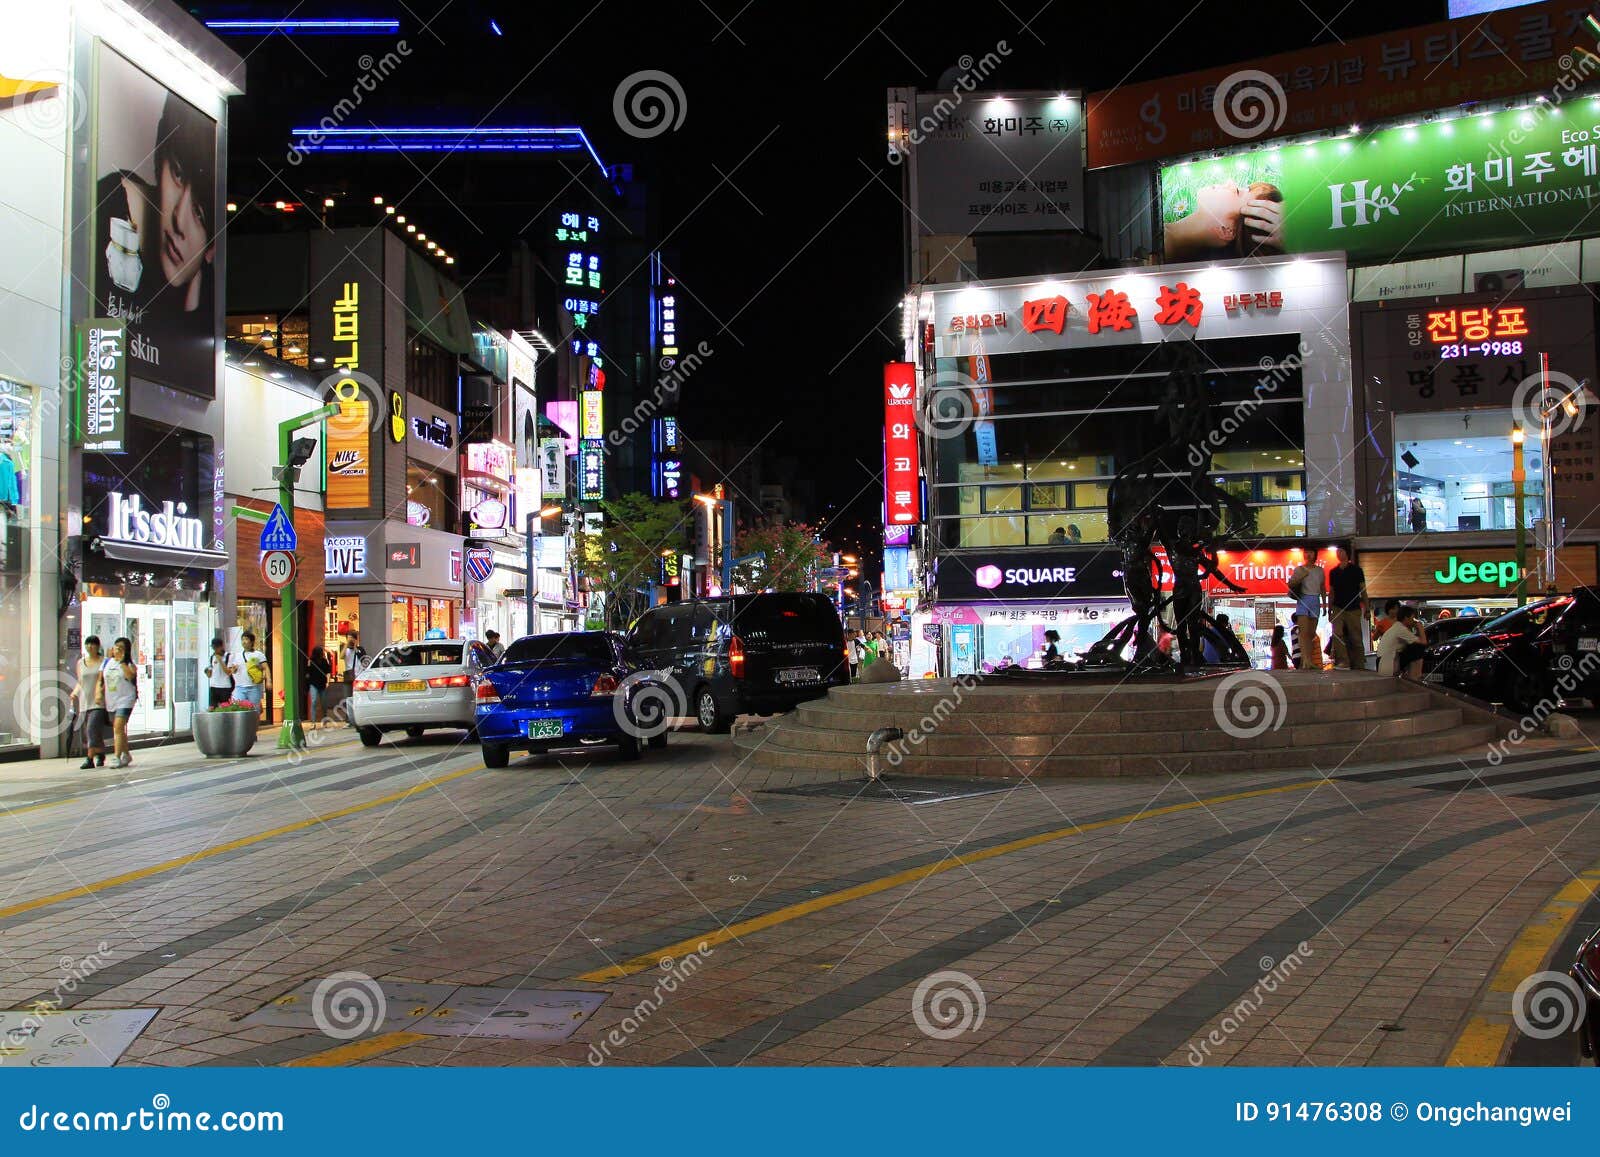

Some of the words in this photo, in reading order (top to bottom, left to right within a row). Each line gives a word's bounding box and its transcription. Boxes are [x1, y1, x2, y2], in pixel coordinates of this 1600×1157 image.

[983, 117, 1045, 137] 화미주
[1048, 119, 1070, 133] (주)
[1561, 129, 1589, 144] Eco
[1444, 184, 1593, 217] INTERNATIONAL
[1023, 281, 1204, 335] 四海坊
[1223, 291, 1284, 312] 만두전문
[951, 312, 1008, 332] 중화요리
[1426, 307, 1529, 343] 전당포
[88, 328, 97, 368] CLINICAL
[99, 328, 122, 370] It's
[130, 333, 160, 365] skin
[1440, 340, 1523, 360] 231-9988
[88, 368, 97, 389] SKIN
[87, 391, 97, 435] SOLUTION
[98, 375, 122, 434] skin
[335, 450, 360, 462] NIKE
[892, 422, 912, 507] 와코루
[106, 491, 150, 541] It's
[149, 499, 203, 550] skin
[270, 559, 287, 576] 50
[1005, 567, 1076, 586] SQUARE
[1230, 560, 1300, 584] Triump
[1435, 556, 1518, 588] Jeep
[531, 725, 561, 739] 1652
